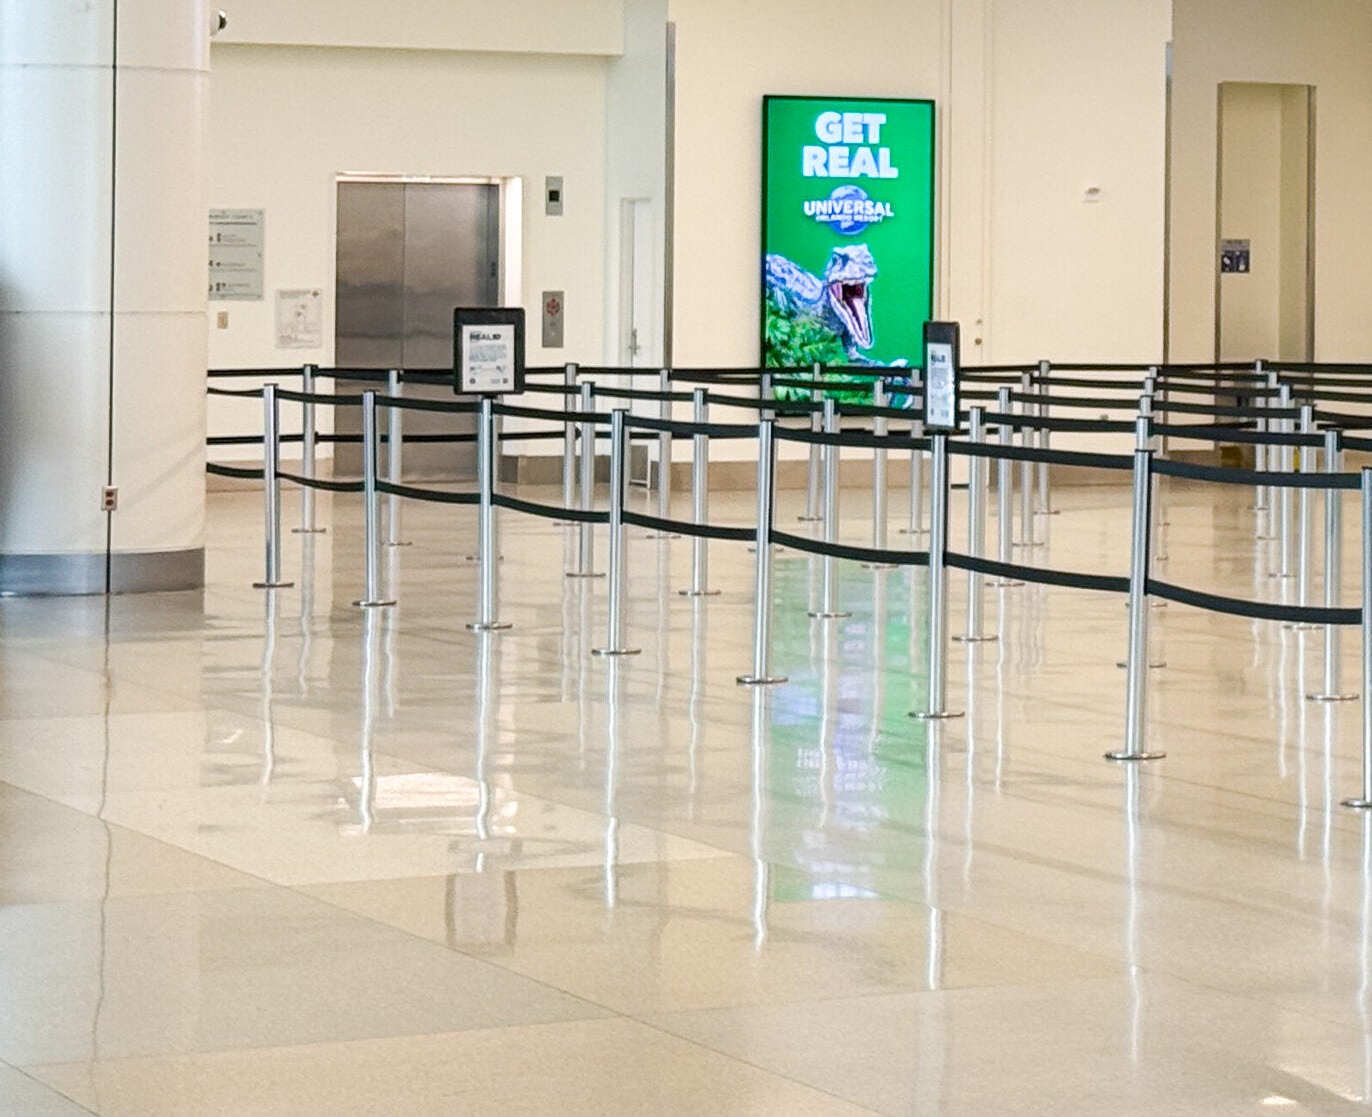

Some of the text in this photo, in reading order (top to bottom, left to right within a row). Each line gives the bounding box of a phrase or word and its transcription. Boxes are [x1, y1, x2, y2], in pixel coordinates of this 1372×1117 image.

[815, 111, 887, 144] GET
[803, 145, 899, 179] REAL
[803, 200, 895, 217] UNIVERSAL
